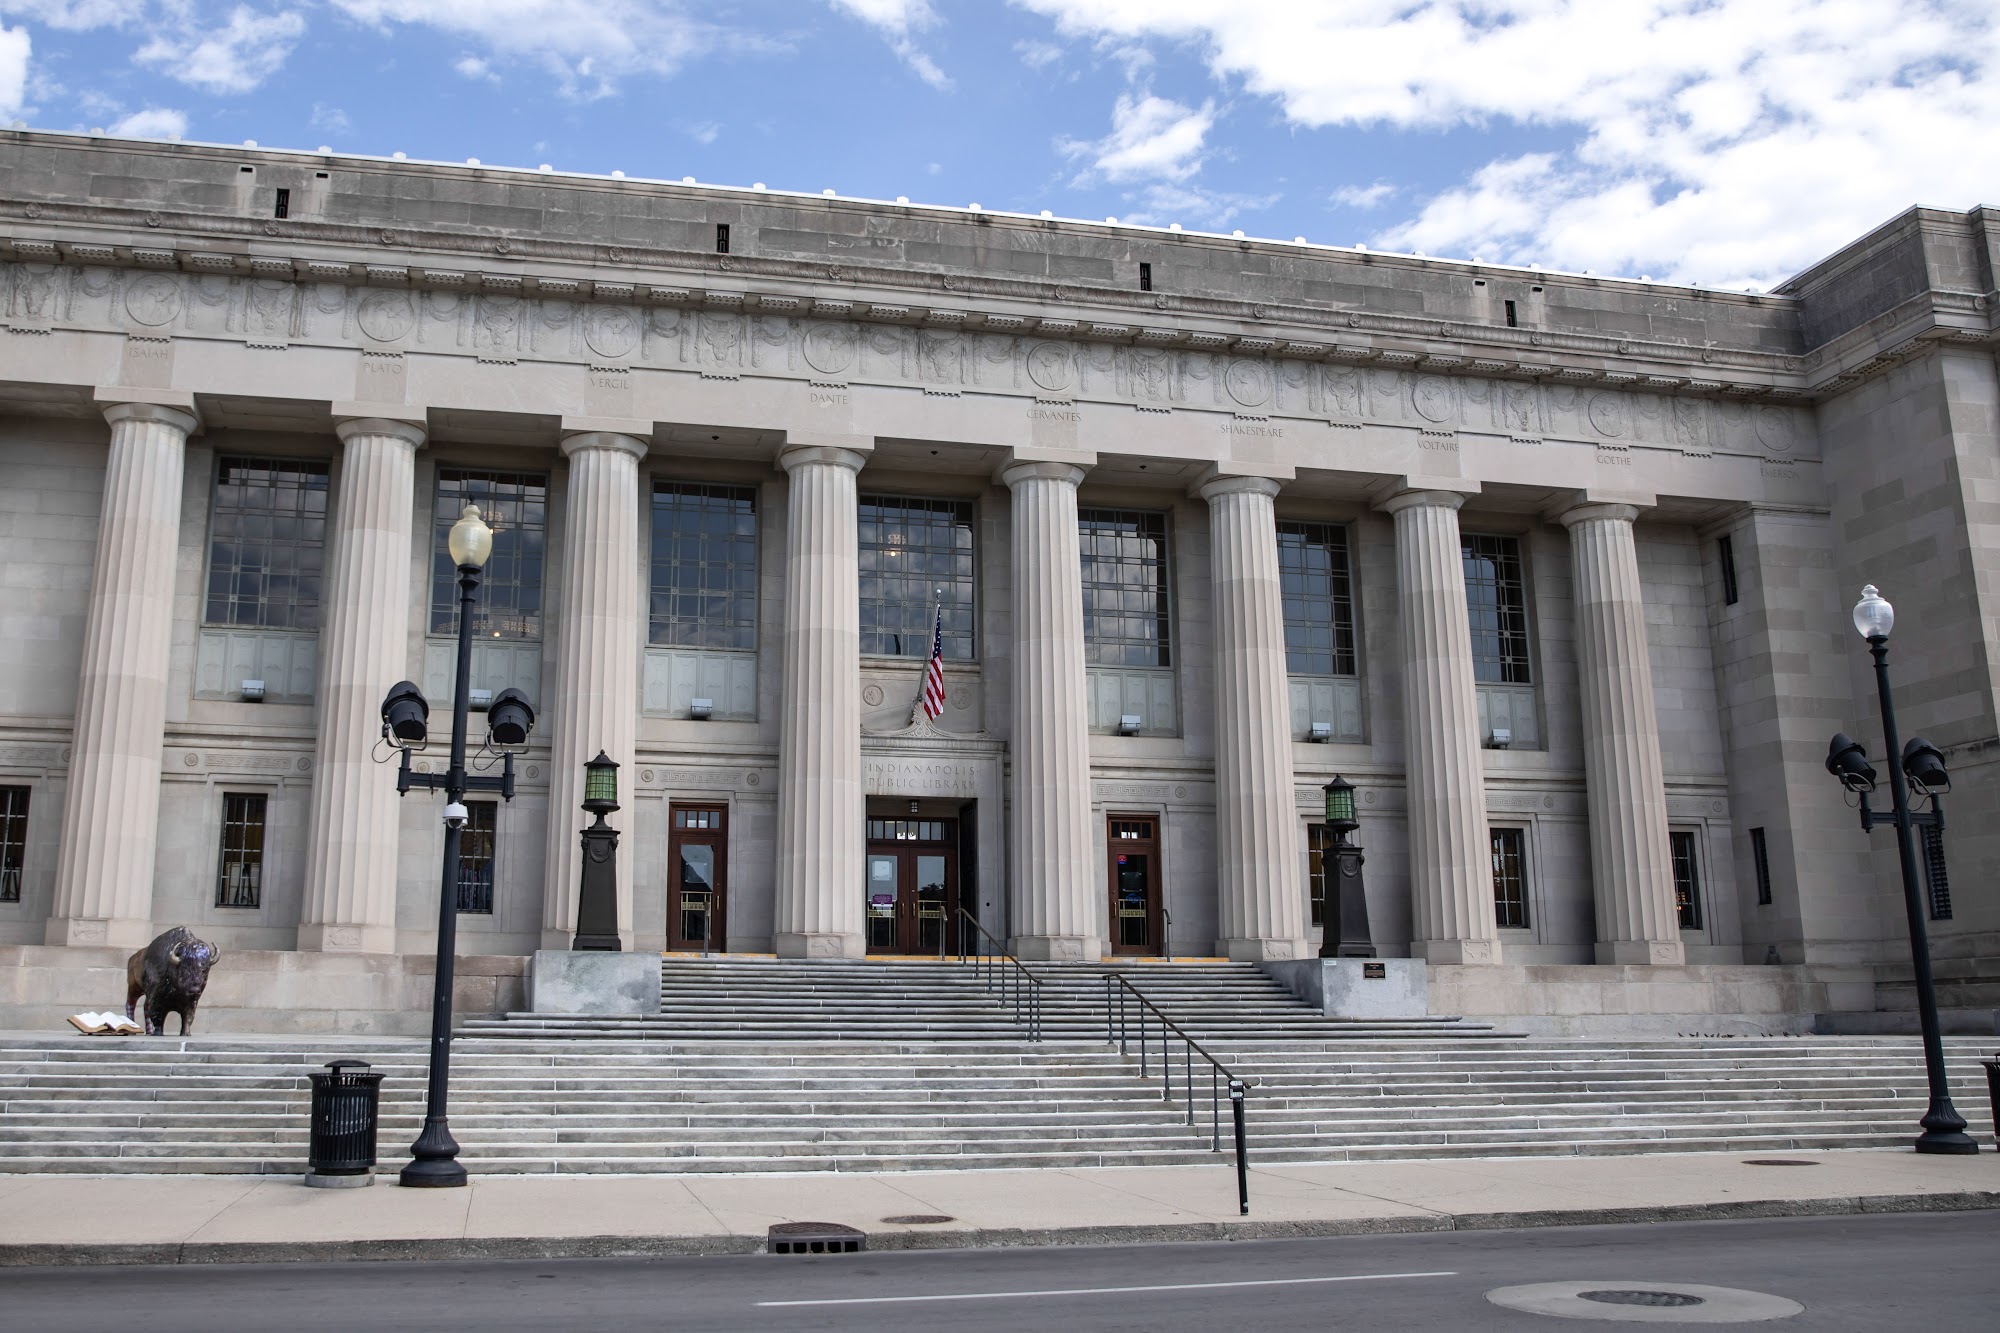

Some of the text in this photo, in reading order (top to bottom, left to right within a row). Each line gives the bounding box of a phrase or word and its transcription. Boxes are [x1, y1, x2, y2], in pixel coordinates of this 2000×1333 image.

[129, 347, 169, 359] ISAIAH
[364, 362, 402, 374] PLATO
[590, 378, 629, 389] VERGIL
[810, 393, 848, 404] DANTE
[1026, 409, 1082, 422] CERVANTES
[1220, 424, 1283, 437] SHAKESPEARE
[1417, 440, 1459, 452] VOLTAIRE
[1596, 455, 1632, 466] GOETHE
[1760, 467, 1800, 479] EMERSON
[869, 763, 975, 775] INDIANAPOLIS
[869, 777, 975, 790] PUBLIC LIBRARY
